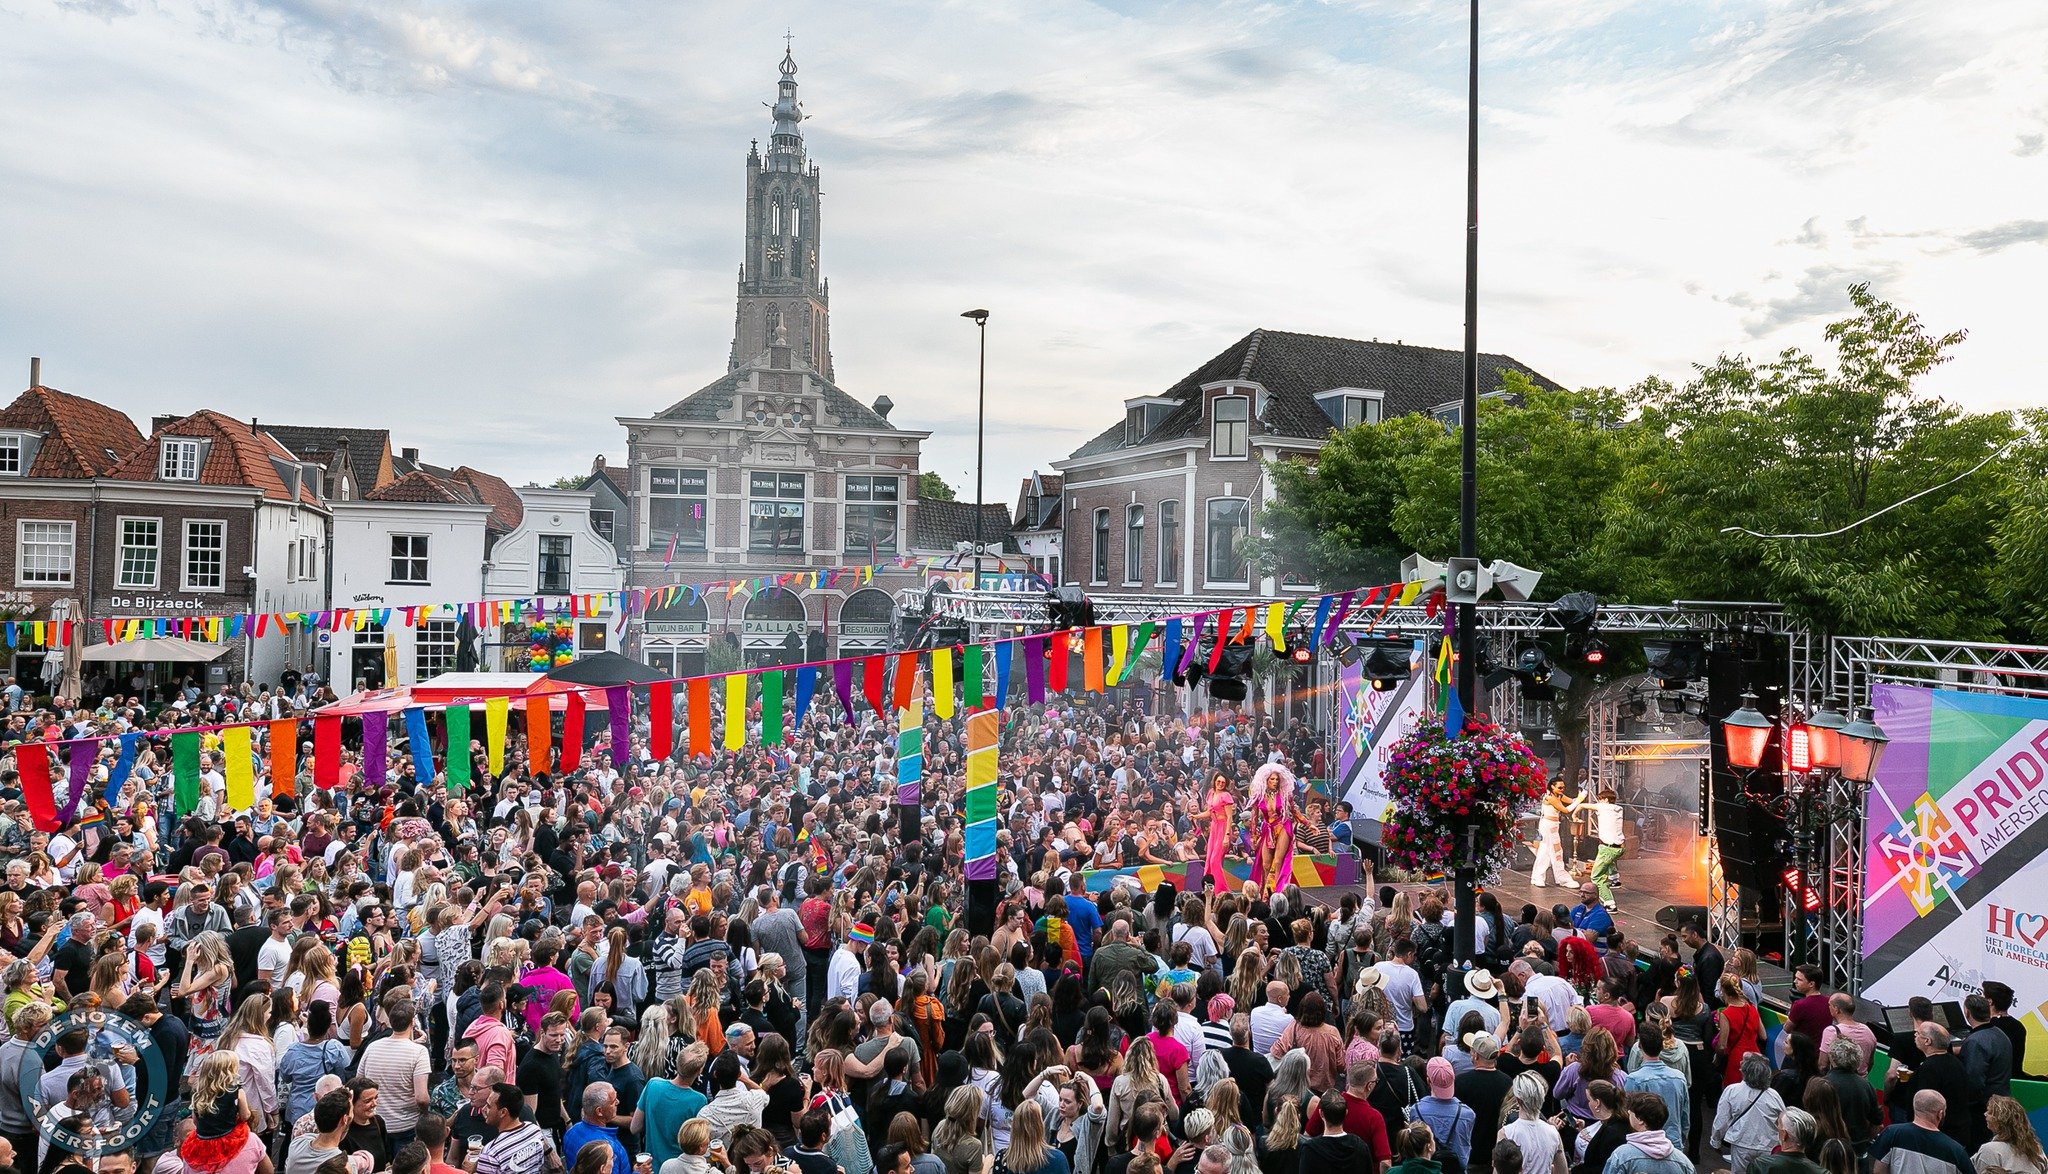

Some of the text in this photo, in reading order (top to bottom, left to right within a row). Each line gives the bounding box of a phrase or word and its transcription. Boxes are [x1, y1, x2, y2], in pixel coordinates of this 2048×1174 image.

[754, 503, 773, 515] OPEN
[929, 575, 1050, 592] COCTAIL
[111, 596, 204, 610] De Bijzaeck
[656, 624, 677, 632] WIJN
[745, 622, 804, 633] PALLAS
[846, 626, 889, 634] RESTAURAN
[1985, 936, 2004, 948] HET
[1985, 944, 2004, 957] VAN
